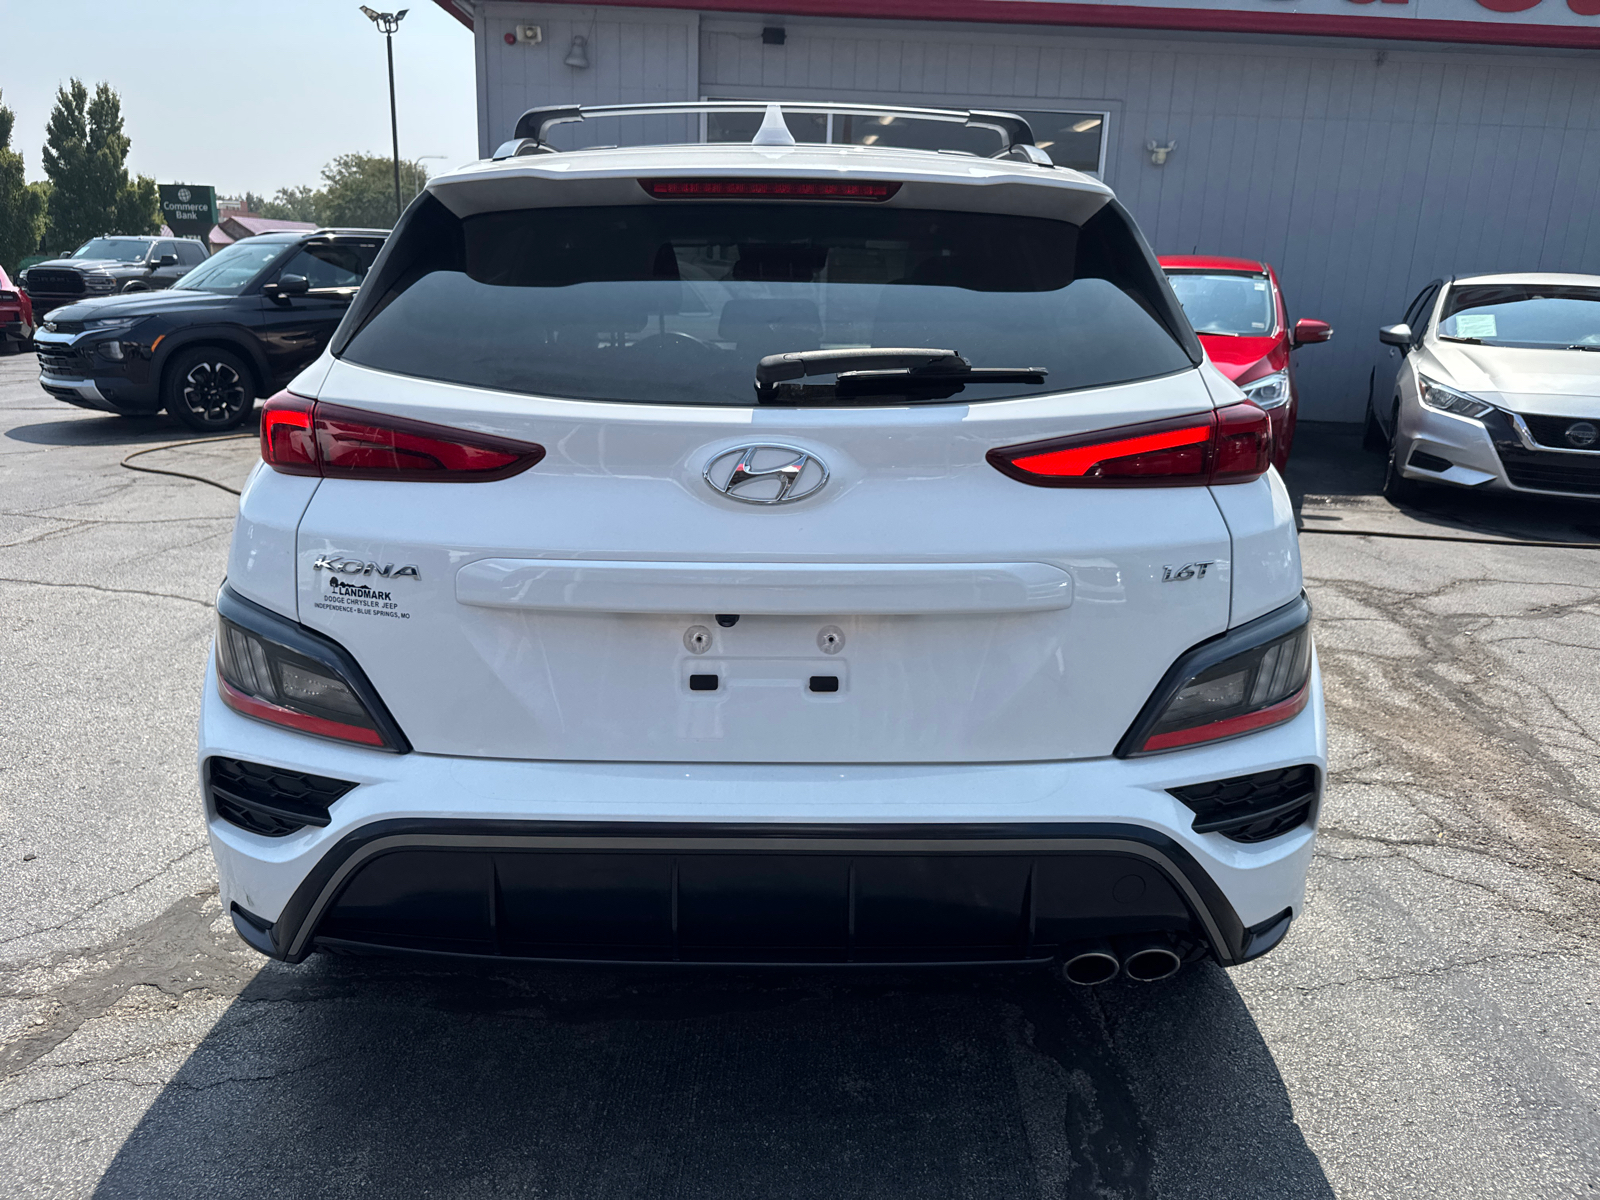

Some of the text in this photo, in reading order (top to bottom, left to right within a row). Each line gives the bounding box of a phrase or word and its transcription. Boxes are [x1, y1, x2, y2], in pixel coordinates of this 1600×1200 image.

[163, 201, 208, 212] Commerce
[175, 211, 198, 220] Bank
[313, 554, 422, 581] KONA
[339, 587, 392, 601] LANDMARK
[324, 595, 398, 610] DODGE CHRYSLER JEEP
[314, 602, 353, 613] INDEPENDENCE
[357, 608, 372, 616] BLUE
[373, 610, 400, 619] SPRINGS,
